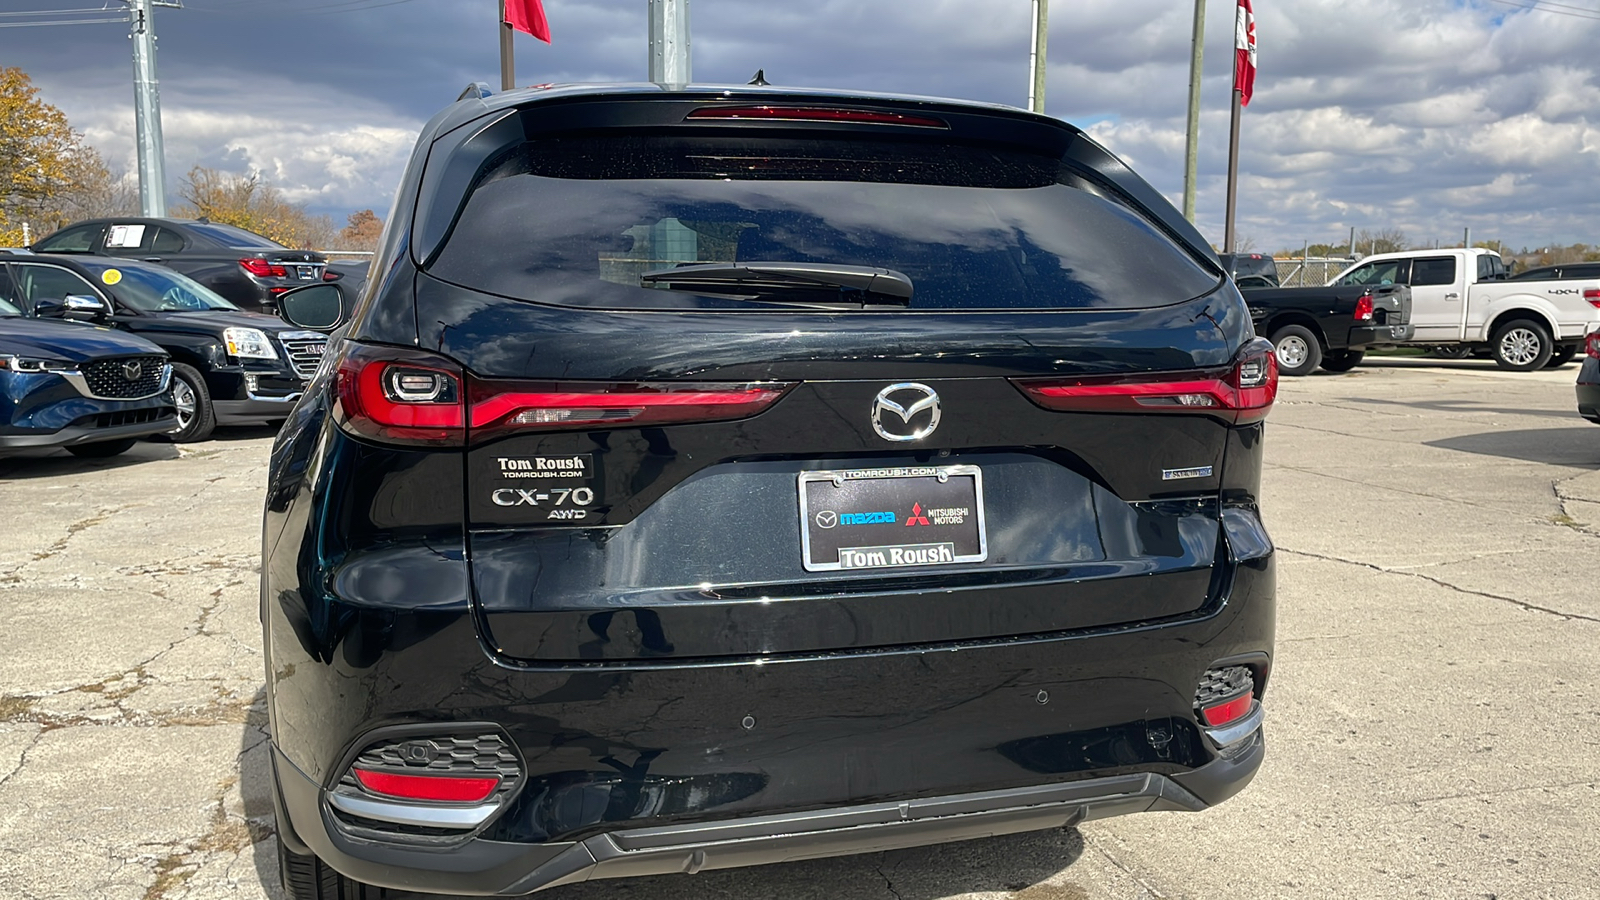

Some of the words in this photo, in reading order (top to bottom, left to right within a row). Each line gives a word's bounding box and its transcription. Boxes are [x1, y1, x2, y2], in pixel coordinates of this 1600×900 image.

[497, 457, 533, 470] Tom
[535, 456, 585, 470] Roush
[846, 467, 936, 478] TOMROUSH.COM
[491, 487, 594, 506] CX-70
[547, 509, 587, 520] AWD
[840, 511, 896, 525] mazda
[927, 507, 969, 518] MITSUBISHI
[934, 516, 964, 526] MOTORS
[841, 549, 887, 568] Tom
[889, 544, 953, 565] Roush
